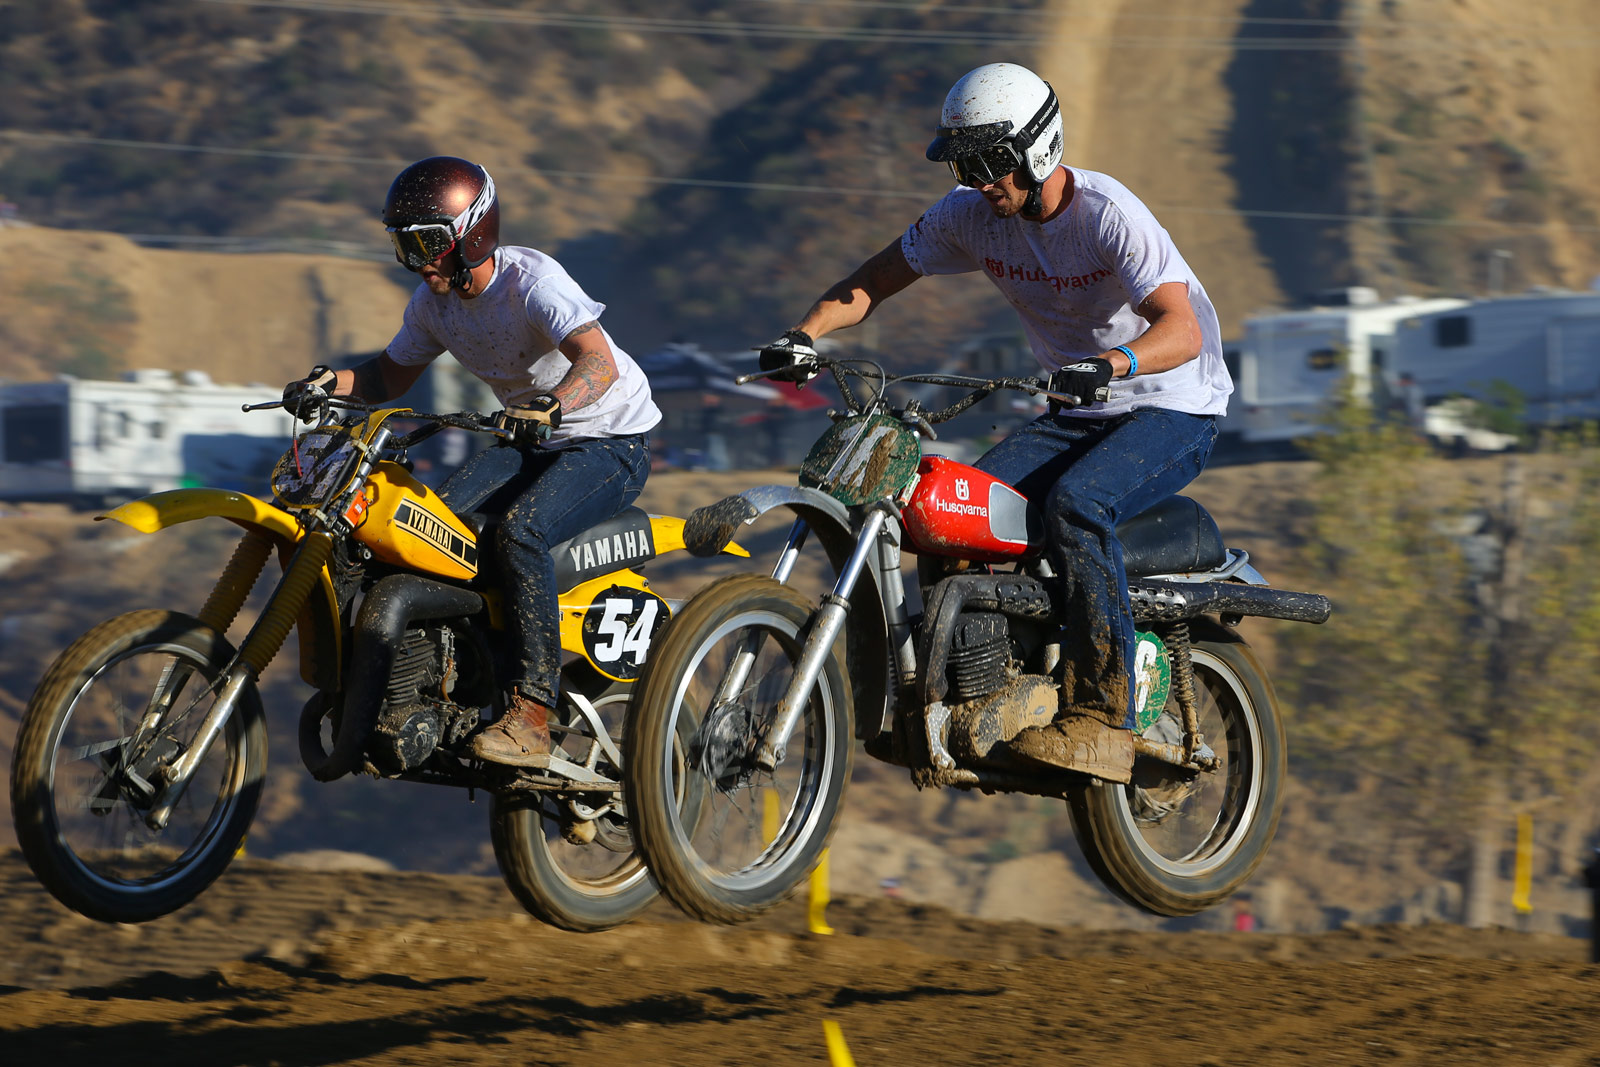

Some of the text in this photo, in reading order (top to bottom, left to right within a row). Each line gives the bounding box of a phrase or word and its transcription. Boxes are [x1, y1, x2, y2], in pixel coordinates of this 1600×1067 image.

[936, 498, 988, 517] Husqvarna
[413, 510, 449, 549] YAMAHA
[569, 529, 650, 572] YAMAHA
[594, 598, 659, 665] 54
